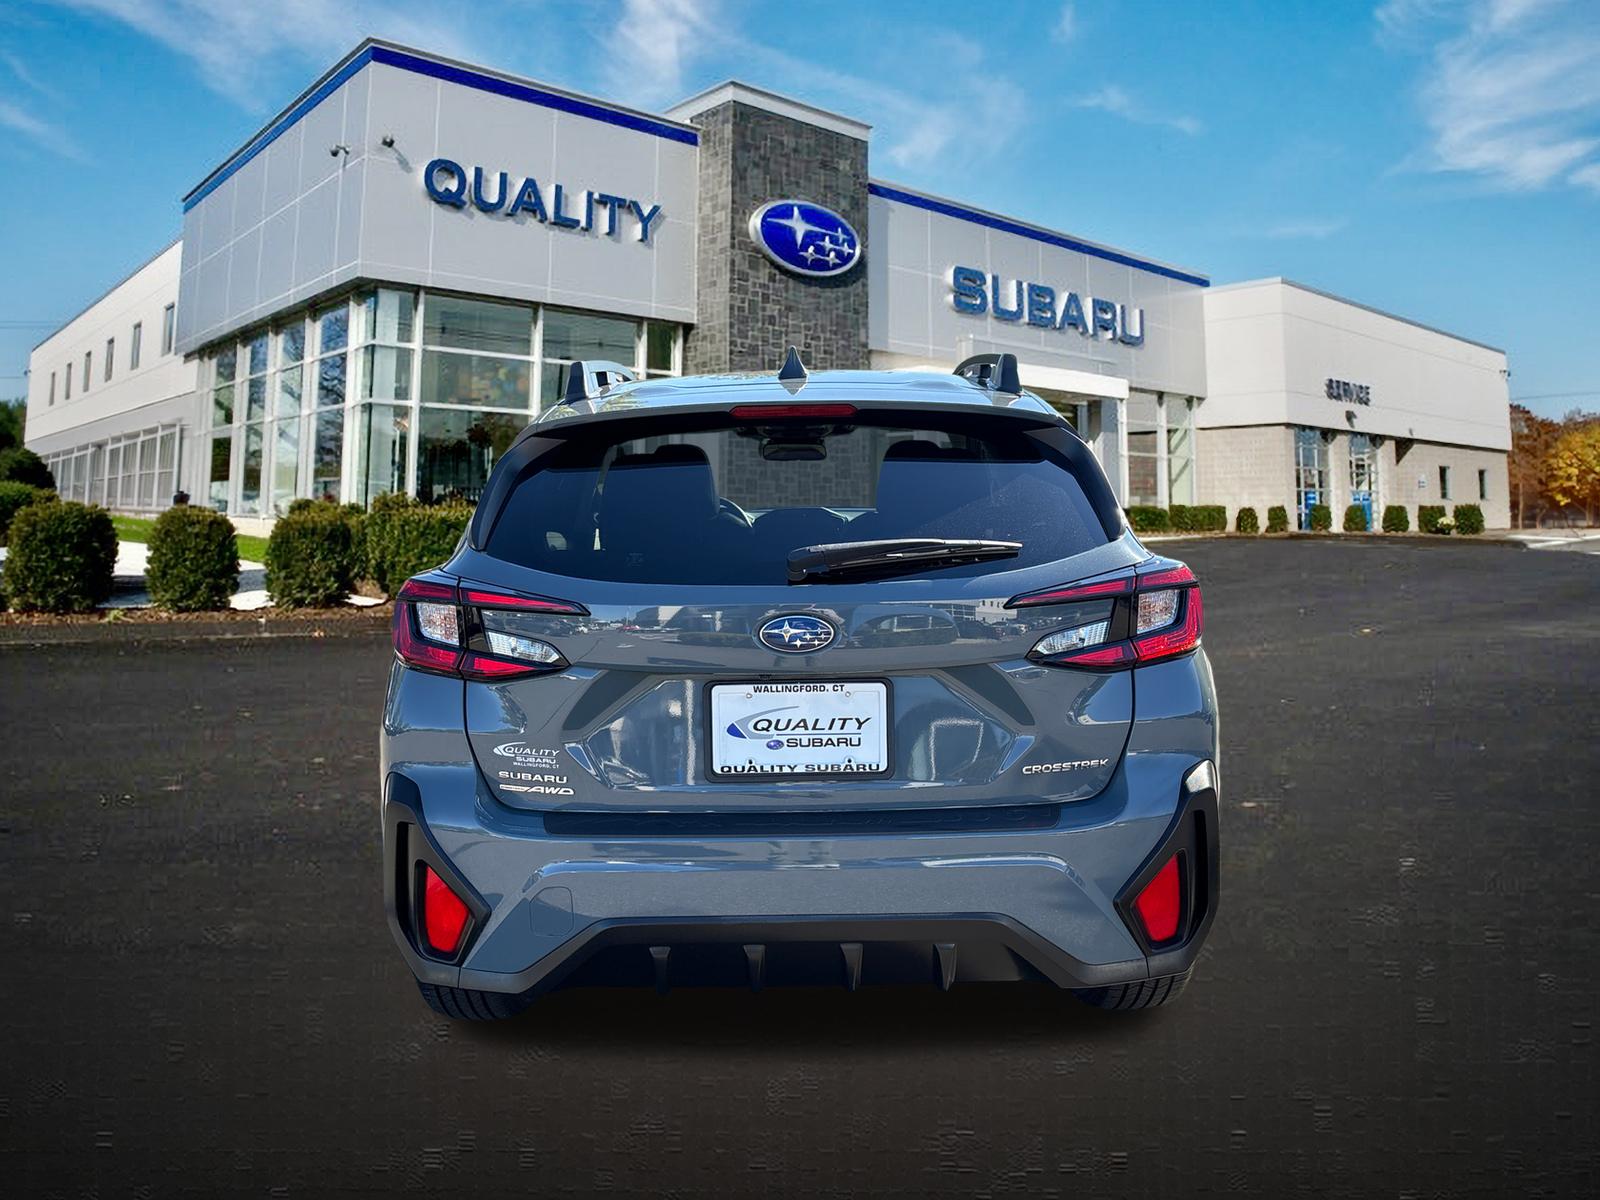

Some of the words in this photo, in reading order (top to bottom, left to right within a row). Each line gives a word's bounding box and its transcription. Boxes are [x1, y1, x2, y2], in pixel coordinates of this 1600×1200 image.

[424, 158, 661, 242] QUALITY
[948, 265, 1145, 346] SUBARU
[832, 684, 845, 692] CT
[753, 718, 872, 732] QUALITY
[786, 737, 861, 748] SUBARU
[505, 746, 560, 756] QUALITY
[720, 764, 797, 773] QUALITY
[804, 763, 880, 772] SUBARU
[1022, 759, 1109, 774] CROSSTREK
[498, 771, 567, 783] SUBARU
[527, 786, 574, 795] AWD
